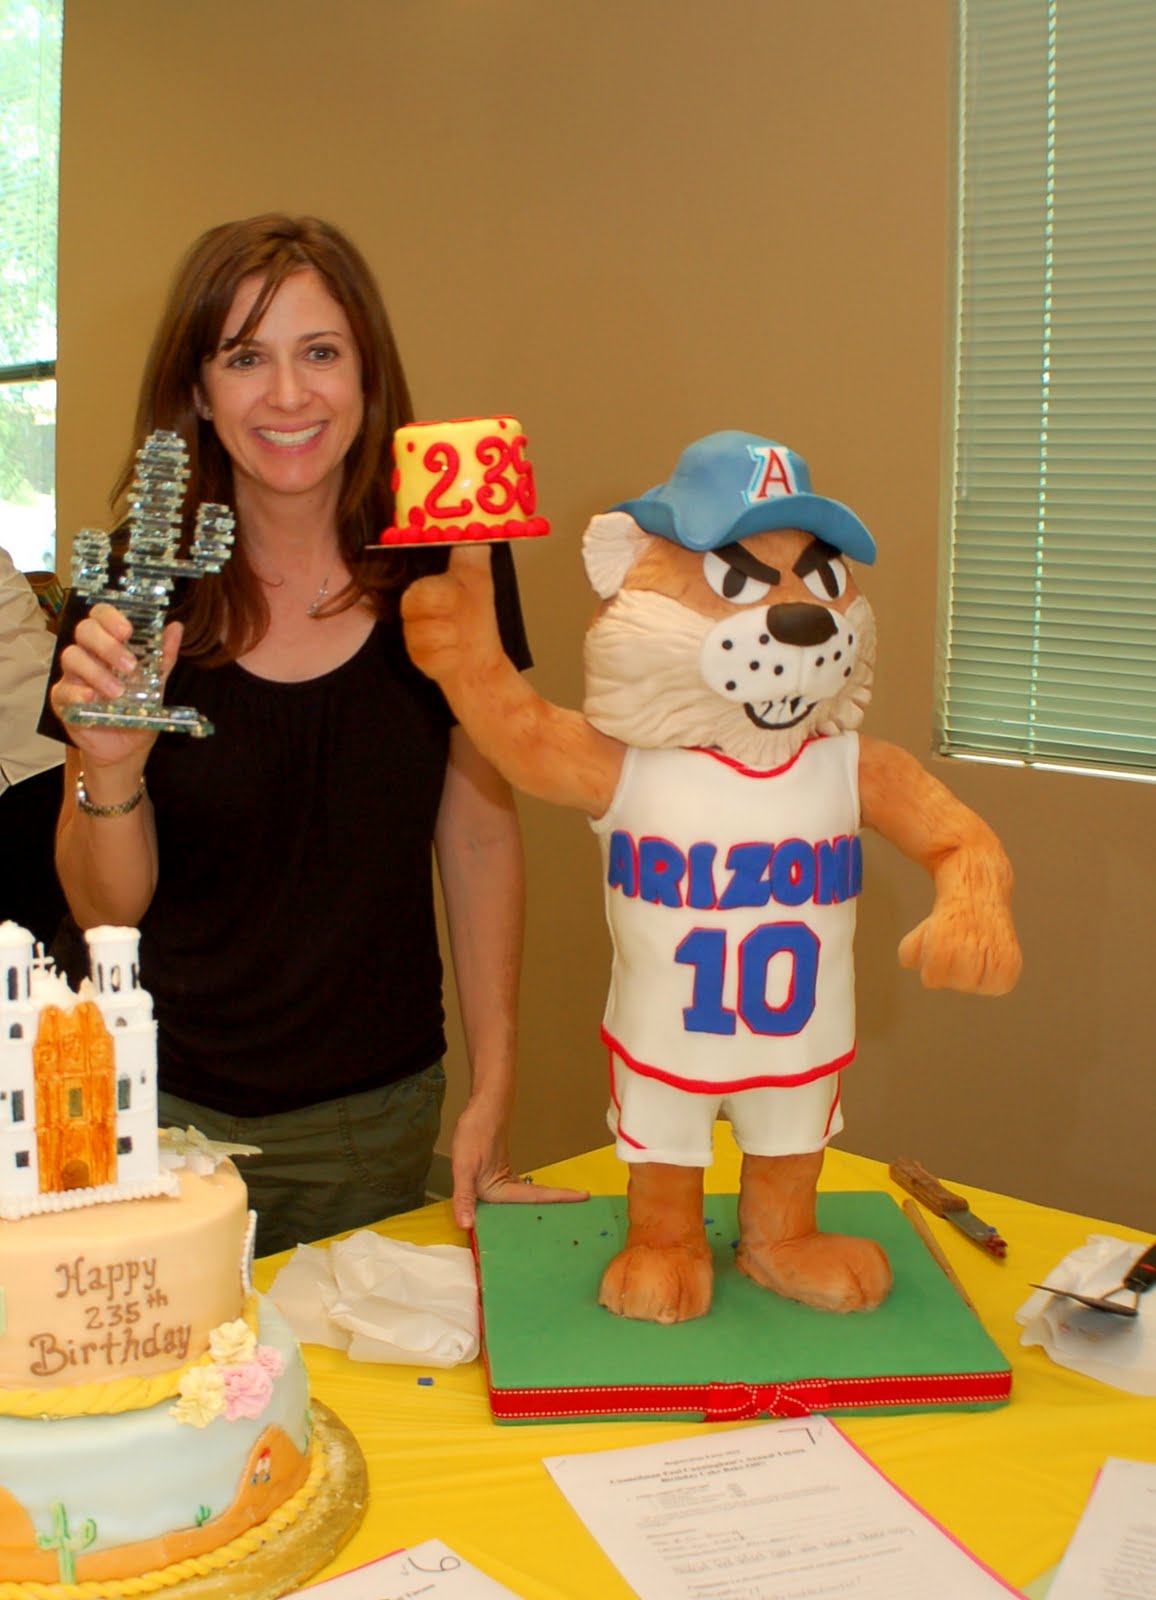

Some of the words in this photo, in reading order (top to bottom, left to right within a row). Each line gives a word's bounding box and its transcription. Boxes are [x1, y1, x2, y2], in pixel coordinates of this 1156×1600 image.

[743, 445, 798, 505] A
[674, 921, 821, 1037] 10
[55, 1255, 158, 1302] Happy
[29, 1322, 192, 1377] Birthday
